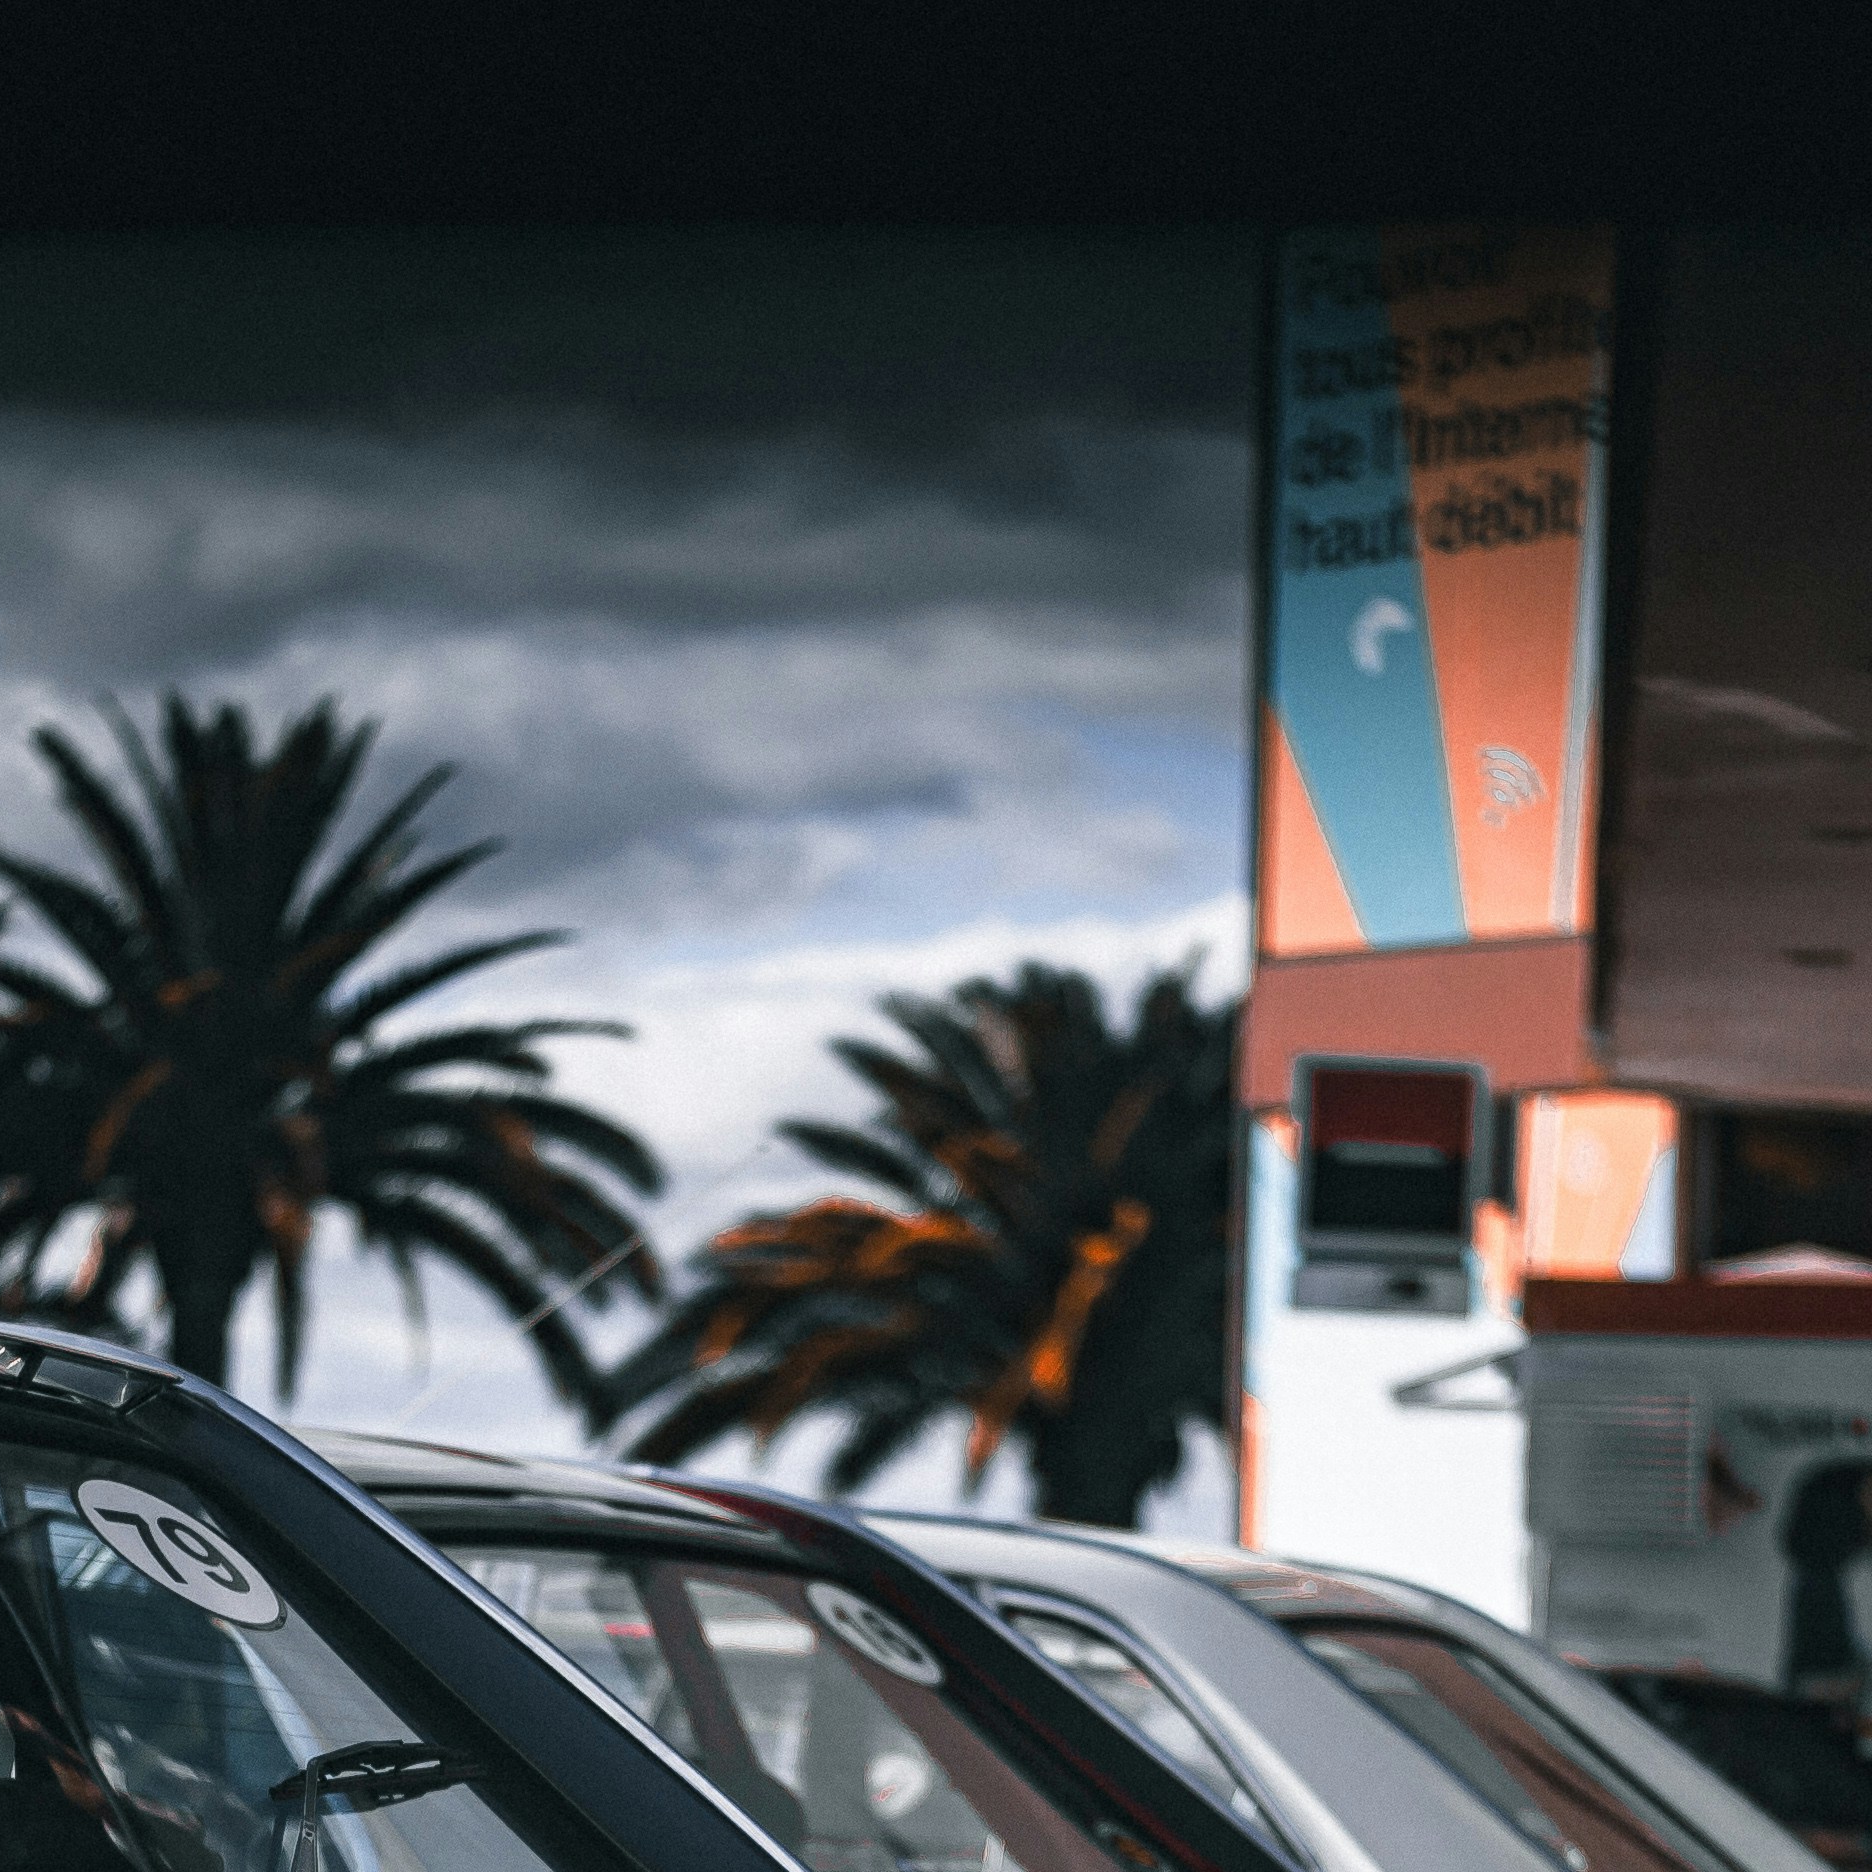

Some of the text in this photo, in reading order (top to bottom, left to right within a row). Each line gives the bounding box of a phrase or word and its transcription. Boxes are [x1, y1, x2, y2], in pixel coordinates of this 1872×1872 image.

[1294, 333, 1420, 400] tous
[1288, 415, 1366, 488] de
[1288, 466, 1581, 570] haut débit
[94, 1507, 250, 1593] 79
